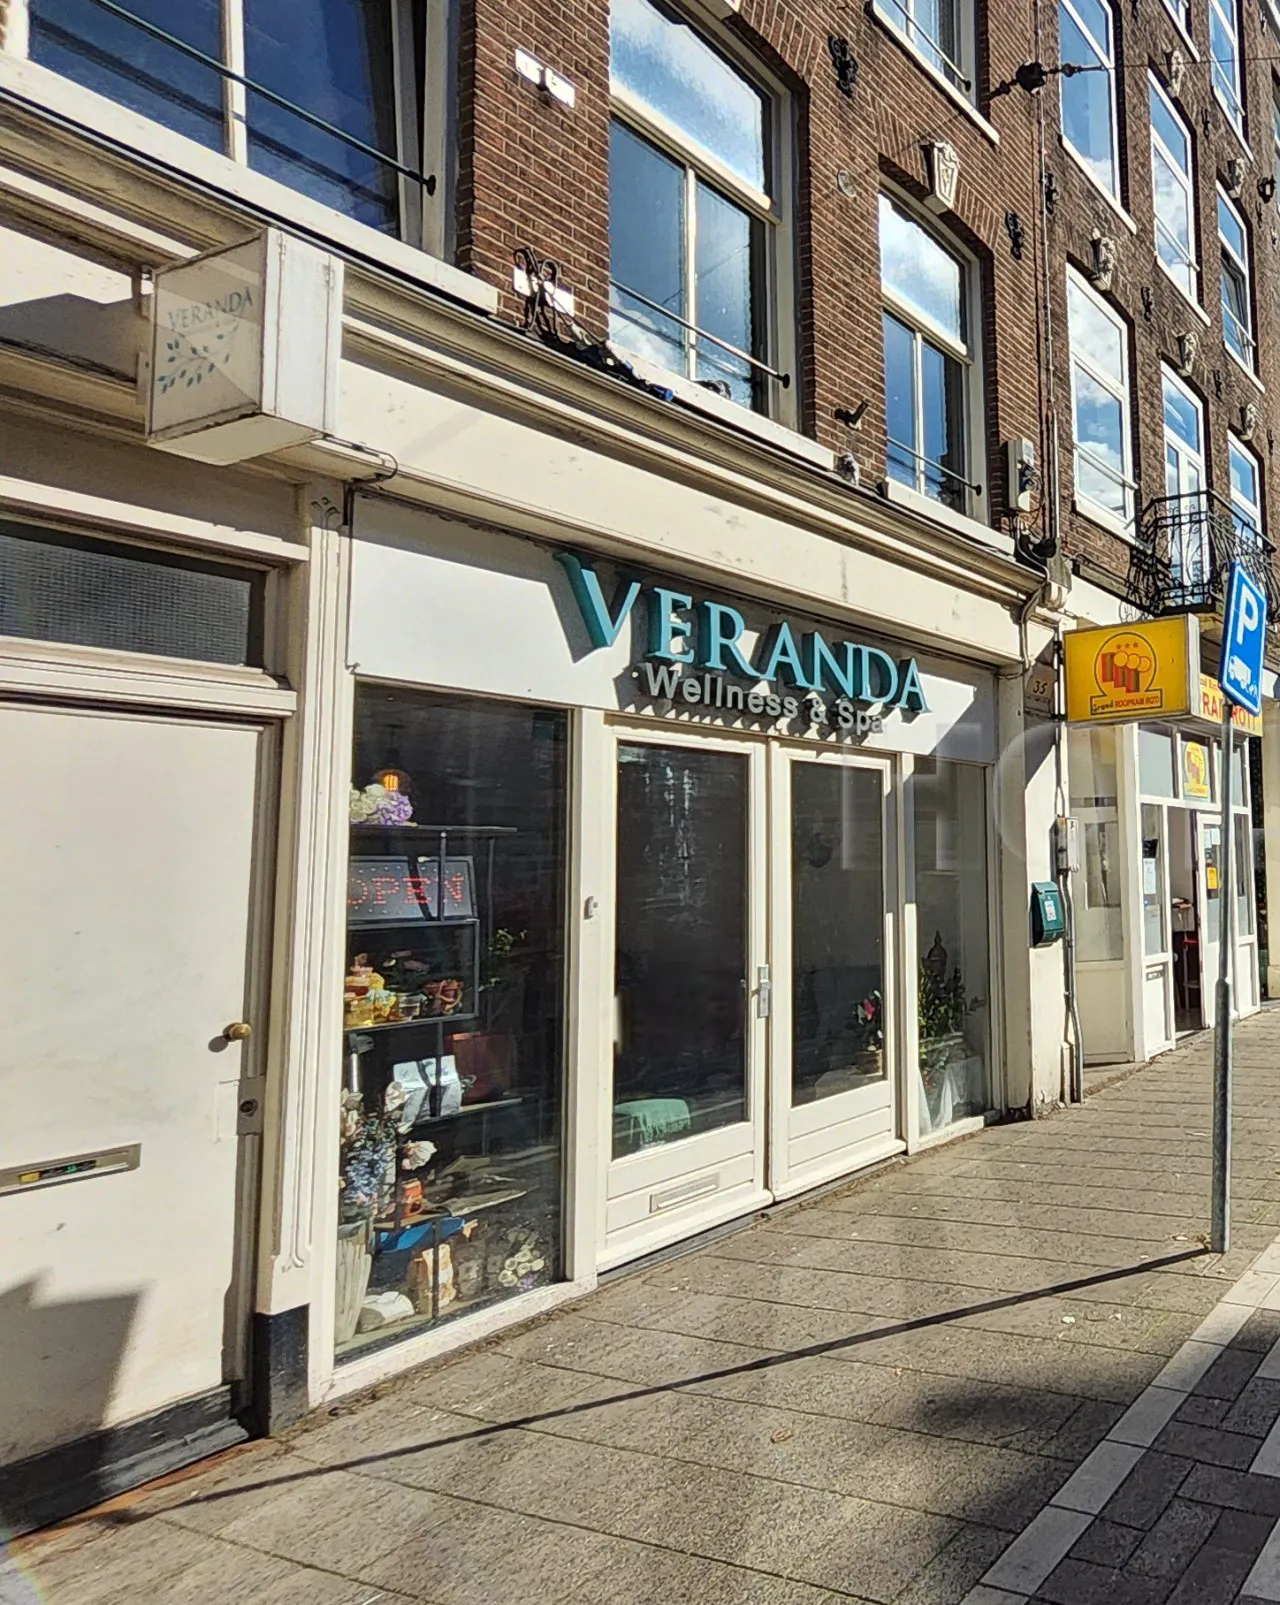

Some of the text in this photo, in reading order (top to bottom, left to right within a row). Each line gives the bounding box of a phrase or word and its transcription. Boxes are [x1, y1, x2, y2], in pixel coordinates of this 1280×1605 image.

[167, 286, 254, 332] VERANDA
[553, 551, 932, 714] VERANDA
[1236, 582, 1259, 646] P
[645, 662, 884, 736] Wellness & Spa
[1032, 680, 1048, 695] 35
[347, 872, 465, 905] OPEN
